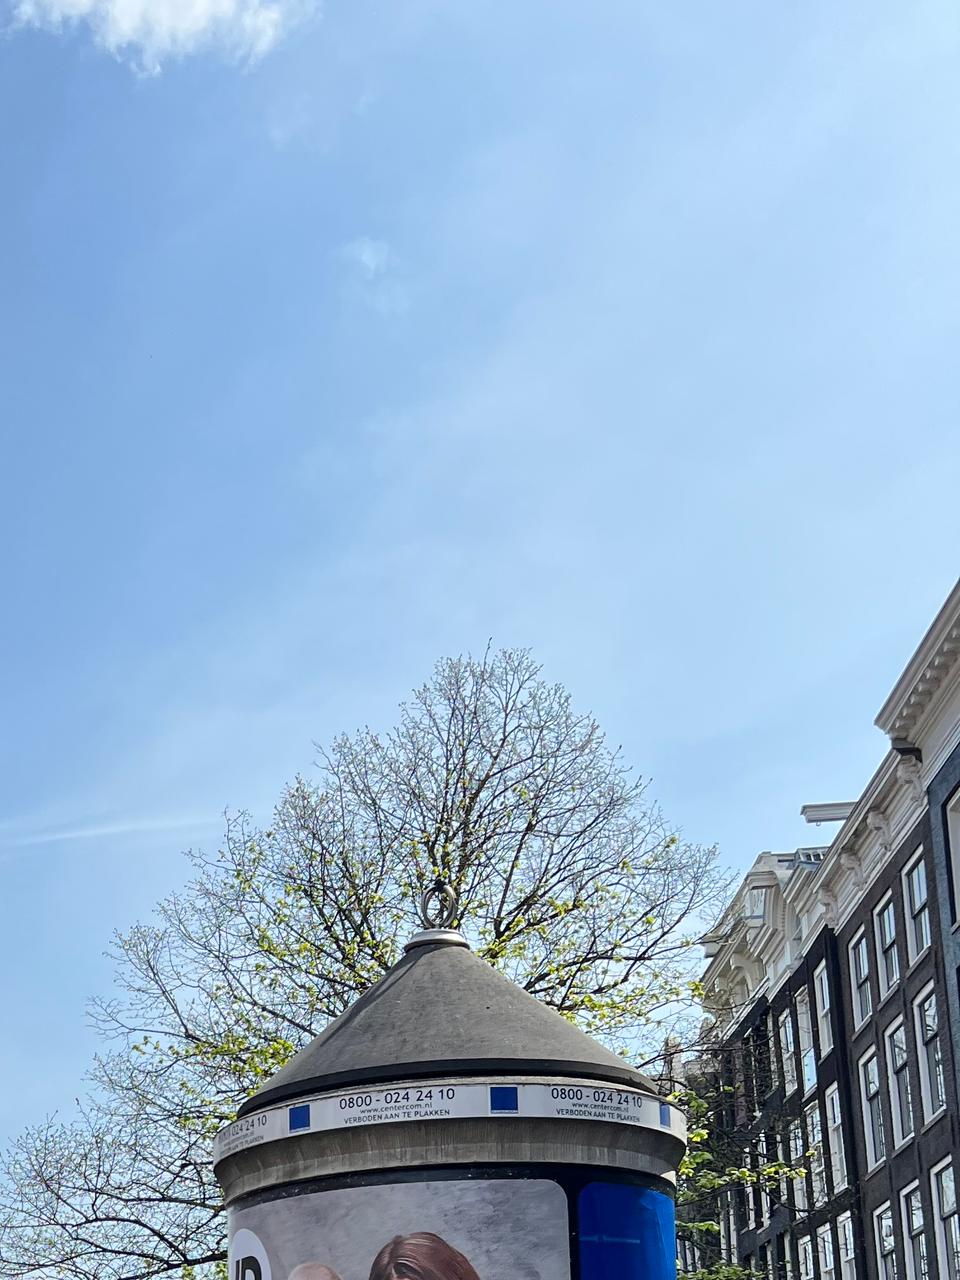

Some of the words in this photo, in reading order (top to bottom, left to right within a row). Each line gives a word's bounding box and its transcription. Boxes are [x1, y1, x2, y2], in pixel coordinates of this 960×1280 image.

[340, 1095, 372, 1110] 0800
[384, 1091, 410, 1104] 024
[416, 1089, 433, 1102] 24
[438, 1088, 455, 1100] 10
[551, 1088, 582, 1100] 0800
[593, 1090, 613, 1103] 024
[618, 1094, 629, 1106] 24
[632, 1096, 642, 1108] 10
[344, 1114, 382, 1124] VERBODEN
[384, 1112, 400, 1120] AAN
[402, 1110, 412, 1118] TE
[414, 1109, 450, 1118] PLAKKEN
[556, 1108, 592, 1116] VERBODEN
[258, 1114, 267, 1126] 10
